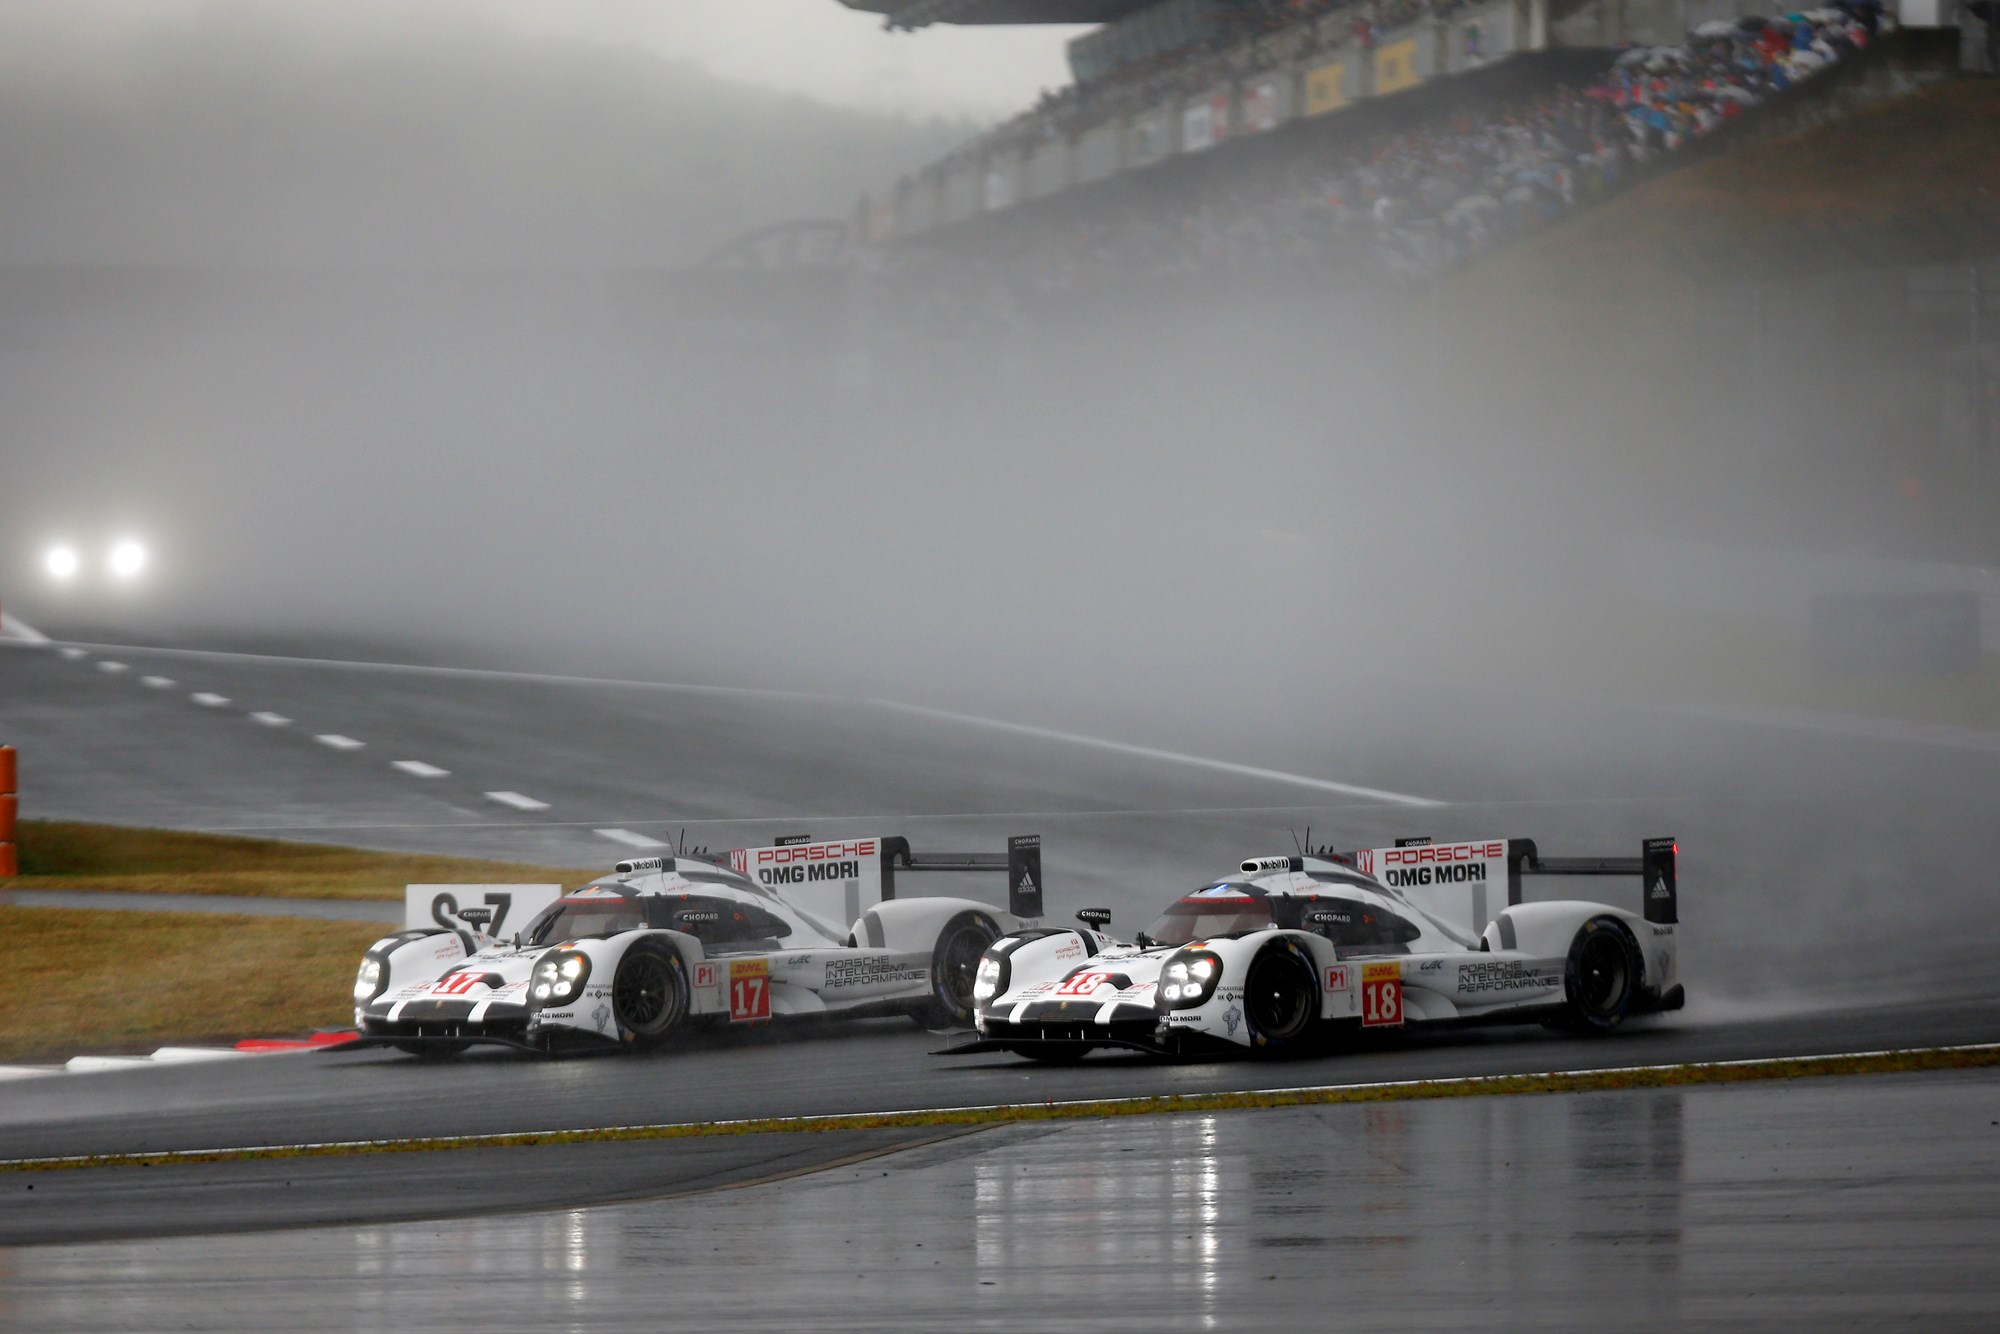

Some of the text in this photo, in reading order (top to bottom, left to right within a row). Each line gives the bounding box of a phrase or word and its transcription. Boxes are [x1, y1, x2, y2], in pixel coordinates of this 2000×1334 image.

[1015, 837, 1040, 845] CHOPARD
[758, 841, 875, 864] PORSCHE
[1385, 843, 1503, 865] PORSCHE
[759, 861, 859, 885] DMG MORI
[1386, 863, 1486, 887] DMG MORI
[1018, 884, 1036, 893] adidas
[683, 913, 719, 921] CHOPARD
[1314, 914, 1350, 922] CHOPARD
[825, 963, 908, 979] INTELLIGENT
[826, 955, 891, 970] PORSCHE
[1459, 960, 1522, 973] PORSCHE
[434, 973, 486, 993] 17
[698, 967, 713, 984] P1
[824, 969, 927, 988] PERFORMANCE
[1059, 973, 1110, 993] 18
[1330, 970, 1345, 988] P1
[1459, 968, 1541, 983] INTELLIGENT
[1457, 976, 1560, 993] PERFORMANCE
[735, 978, 764, 1015] 17
[1367, 982, 1397, 1020] 18
